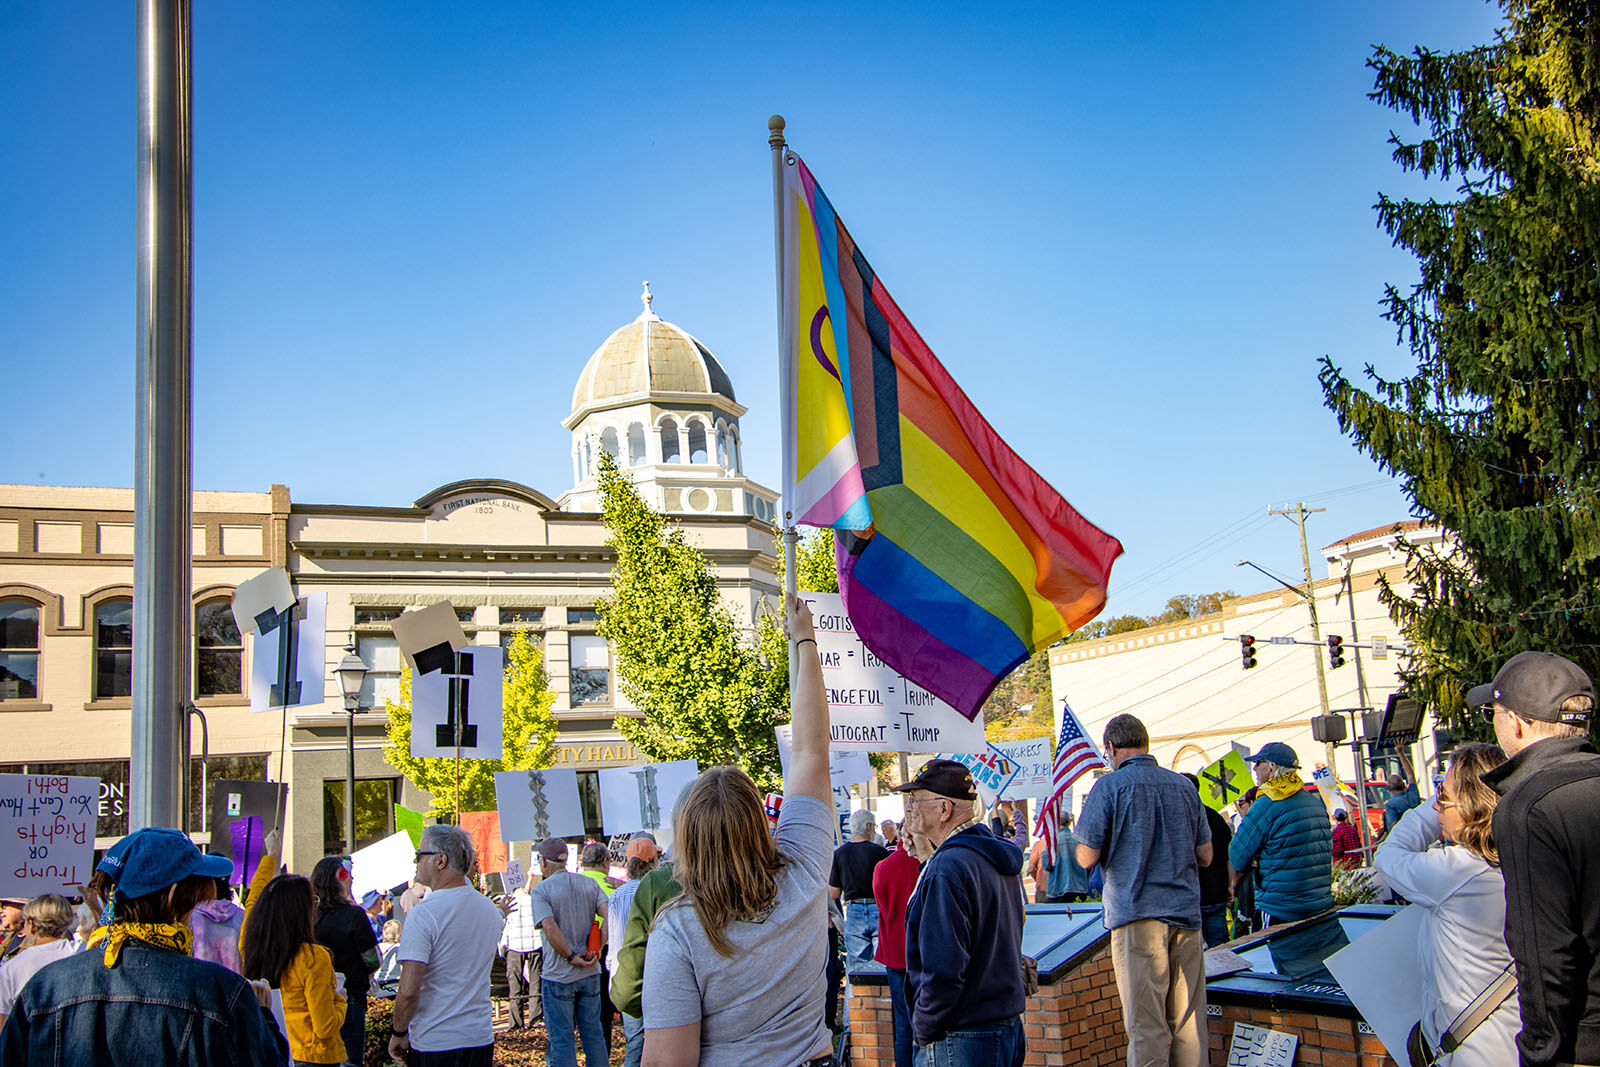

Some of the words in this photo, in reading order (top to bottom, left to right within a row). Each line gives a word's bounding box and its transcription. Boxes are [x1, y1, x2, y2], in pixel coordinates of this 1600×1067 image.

[443, 499, 464, 511] FIRST
[465, 498, 500, 507] NATIONAL
[820, 652, 840, 667] IAR
[825, 688, 884, 705] ENGEFUL
[897, 675, 936, 706] TRUMP
[899, 711, 940, 742] TRUMP
[552, 747, 584, 763] ITY
[588, 745, 638, 761] HALL
[1000, 743, 1042, 760] ONGRESS
[951, 753, 1003, 789] MEANS
[27, 777, 69, 794] Both!
[98, 782, 124, 799] ON
[0, 798, 23, 817] Hav
[27, 797, 64, 816] Can't
[69, 795, 92, 815] You
[97, 800, 124, 817] ES
[17, 815, 86, 845] Rights
[28, 845, 48, 859] OR
[14, 861, 82, 886] Trump
[1229, 1024, 1255, 1067] RTH
